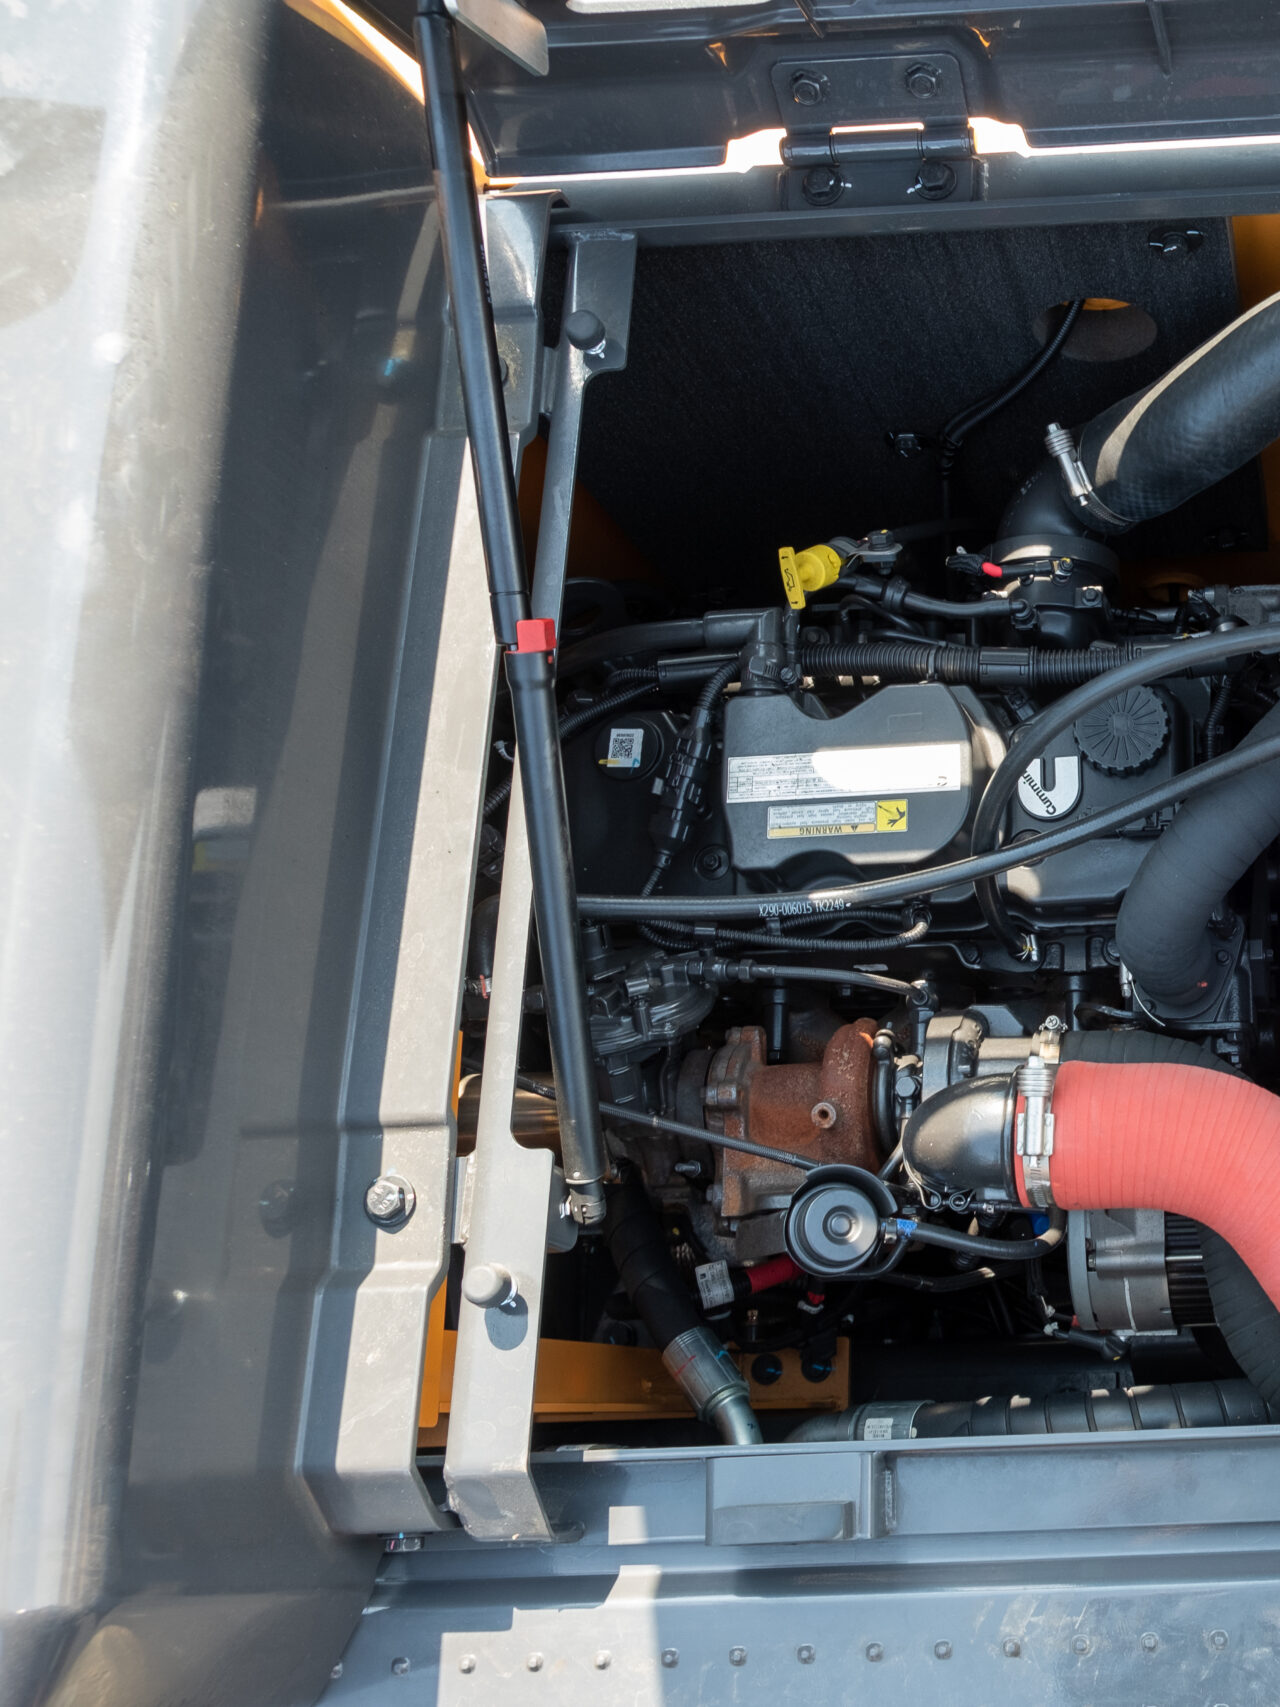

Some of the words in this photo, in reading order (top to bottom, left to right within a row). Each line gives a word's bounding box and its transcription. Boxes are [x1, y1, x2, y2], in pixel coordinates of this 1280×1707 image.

[1021, 770, 1057, 815] Cummin
[800, 825, 842, 835] WARNING
[759, 901, 812, 917] X290-006015
[815, 899, 844, 913] TK2249
